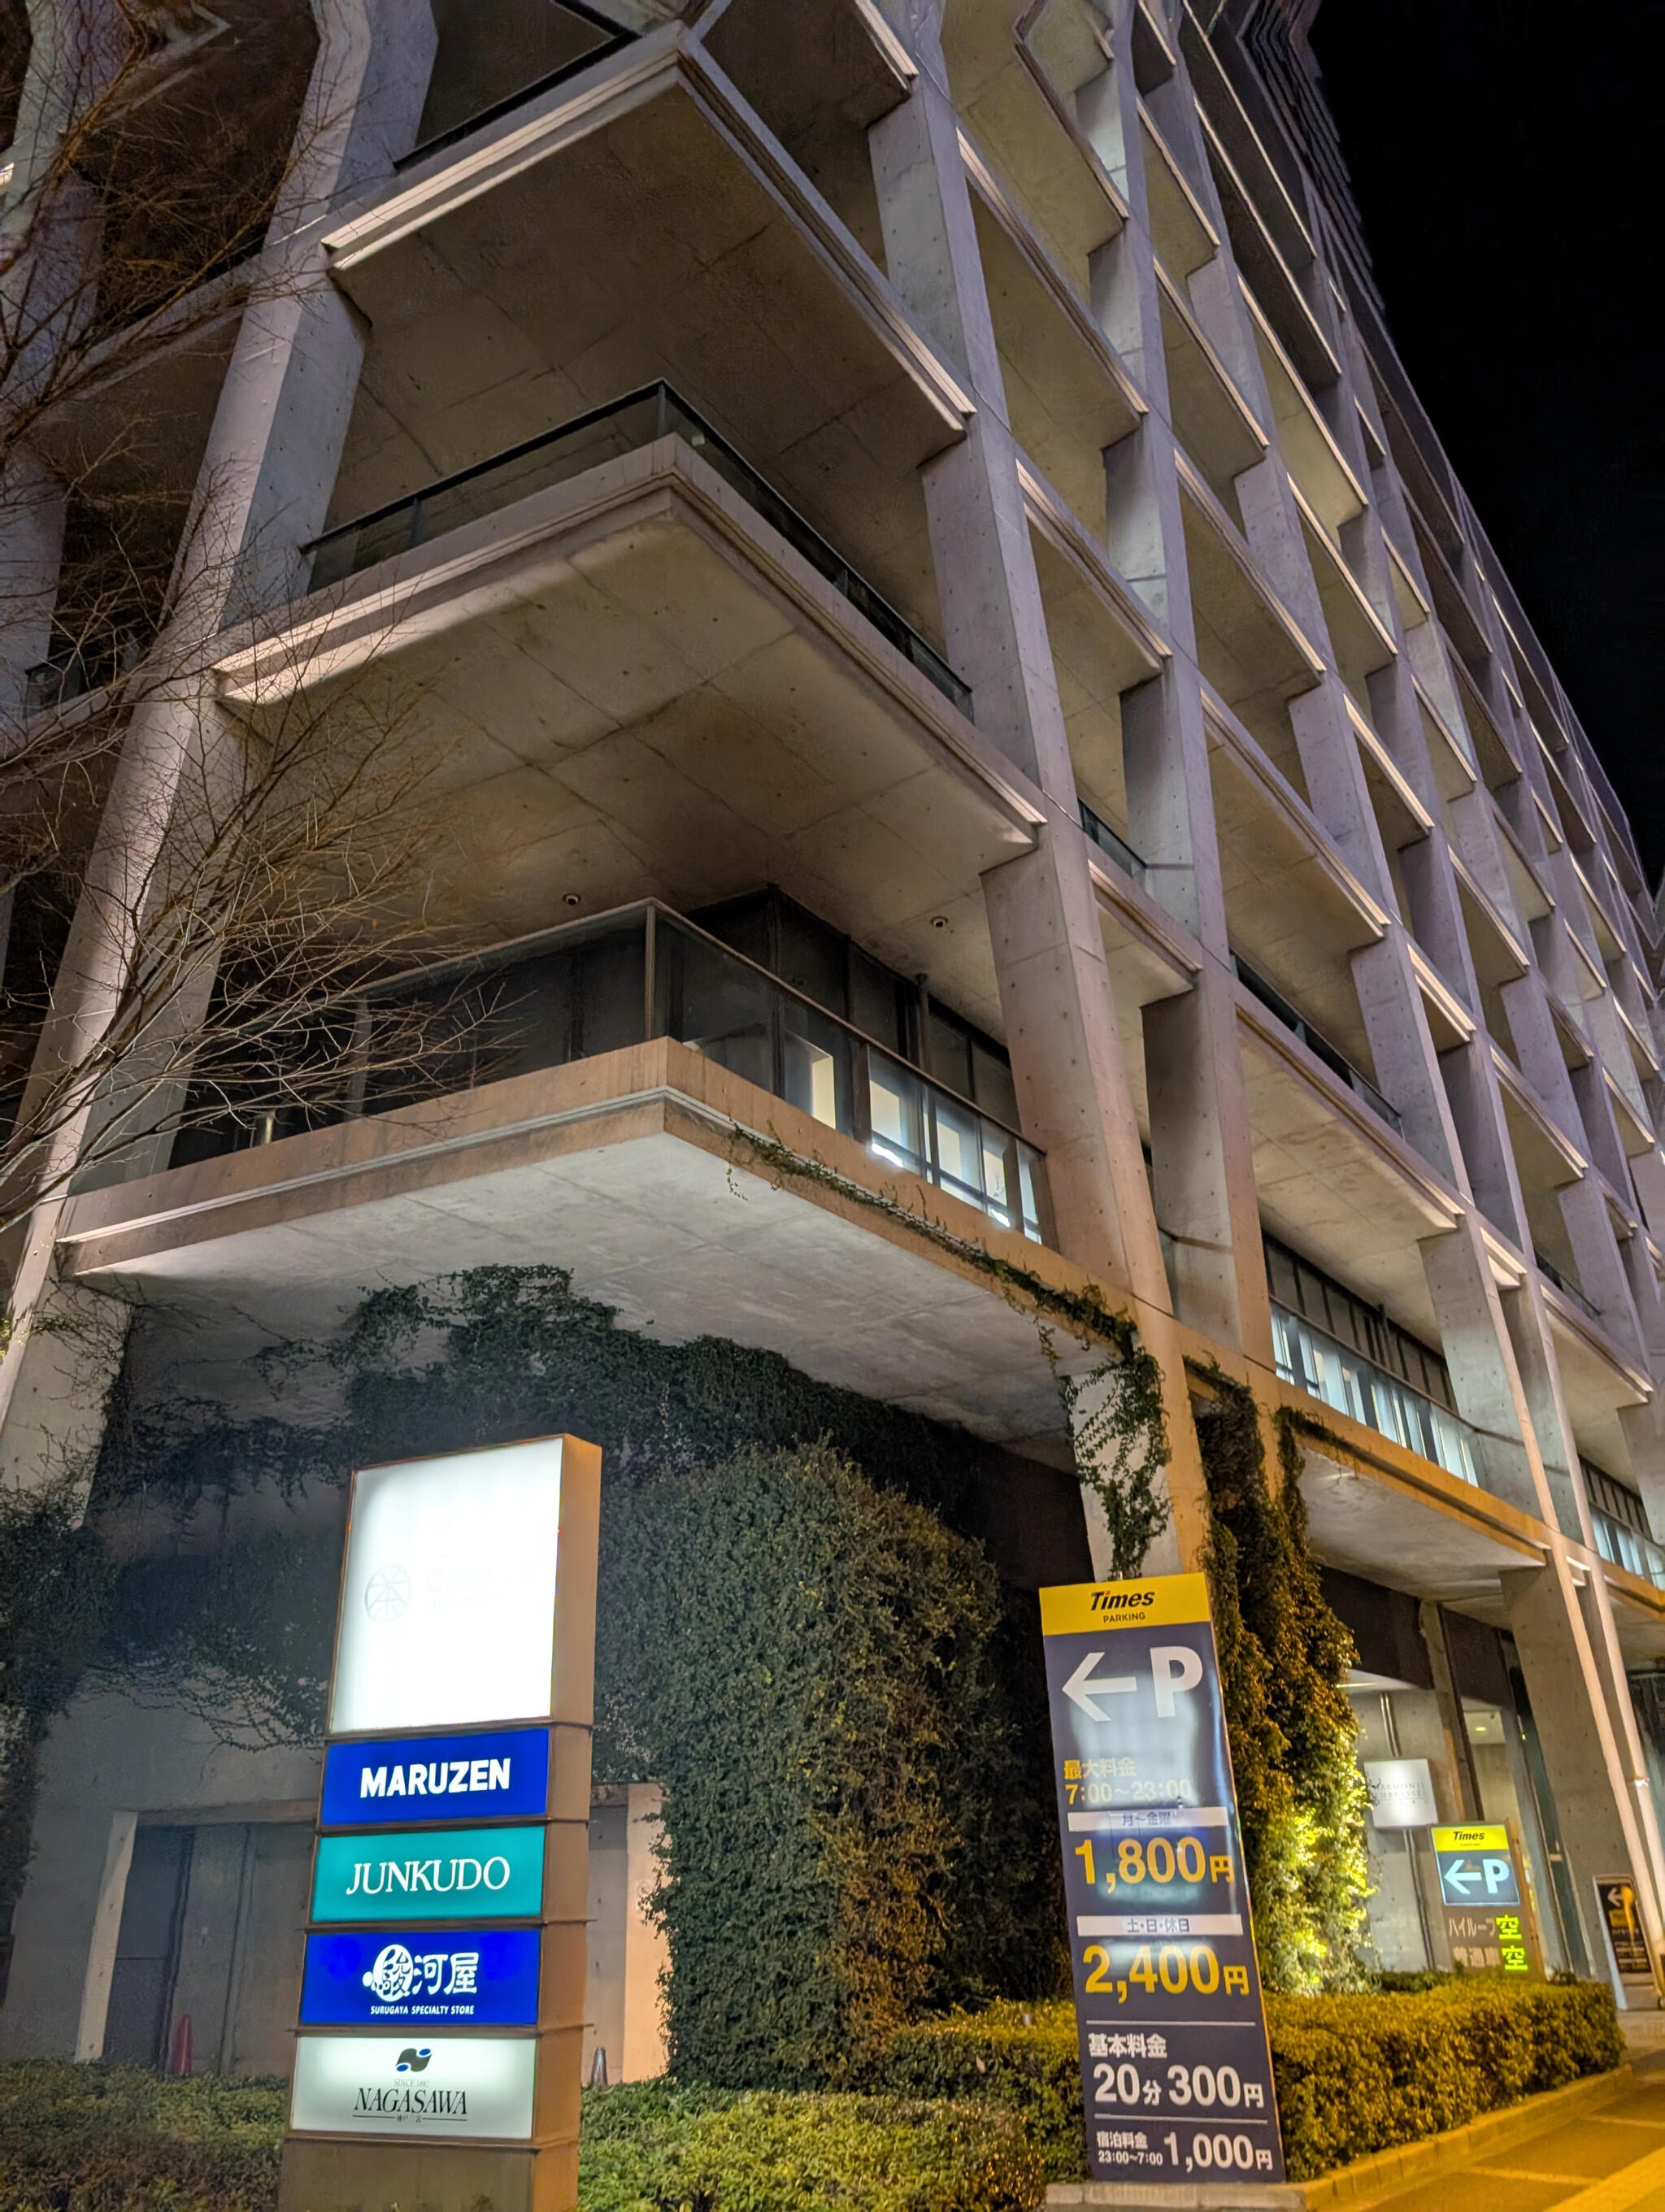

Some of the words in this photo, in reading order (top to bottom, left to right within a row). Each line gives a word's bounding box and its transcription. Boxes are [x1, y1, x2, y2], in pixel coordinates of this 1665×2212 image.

[1090, 1590, 1155, 1611] Times
[1103, 1612, 1146, 1623] PARKING
[1150, 1645, 1203, 1718] P
[360, 1758, 511, 1798] MARUZEN
[1063, 1757, 1137, 1780] 最大料金
[1454, 1831, 1485, 1840] Times
[346, 1856, 511, 1895] JUNKUDO
[1075, 1836, 1235, 1894] 1,800円
[1482, 1858, 1510, 1894] P
[1496, 1914, 1522, 1940] 空
[1502, 1945, 1528, 1971] 空
[1082, 1945, 1250, 2003] 2,400円
[371, 2006, 409, 2014] SURUGAYA
[411, 2006, 449, 2014] SPECIALTY
[451, 2006, 474, 2014] STORE
[1088, 2033, 1167, 2058] 基本料金
[393, 2079, 415, 2087] SINCE
[1093, 2063, 1162, 2106] 20分
[1167, 2065, 1265, 2108] 300円
[354, 2088, 467, 2114] NAGASAWA
[1097, 2132, 1148, 2150] 宿泊料金
[1163, 2132, 1273, 2173] 1,000円
